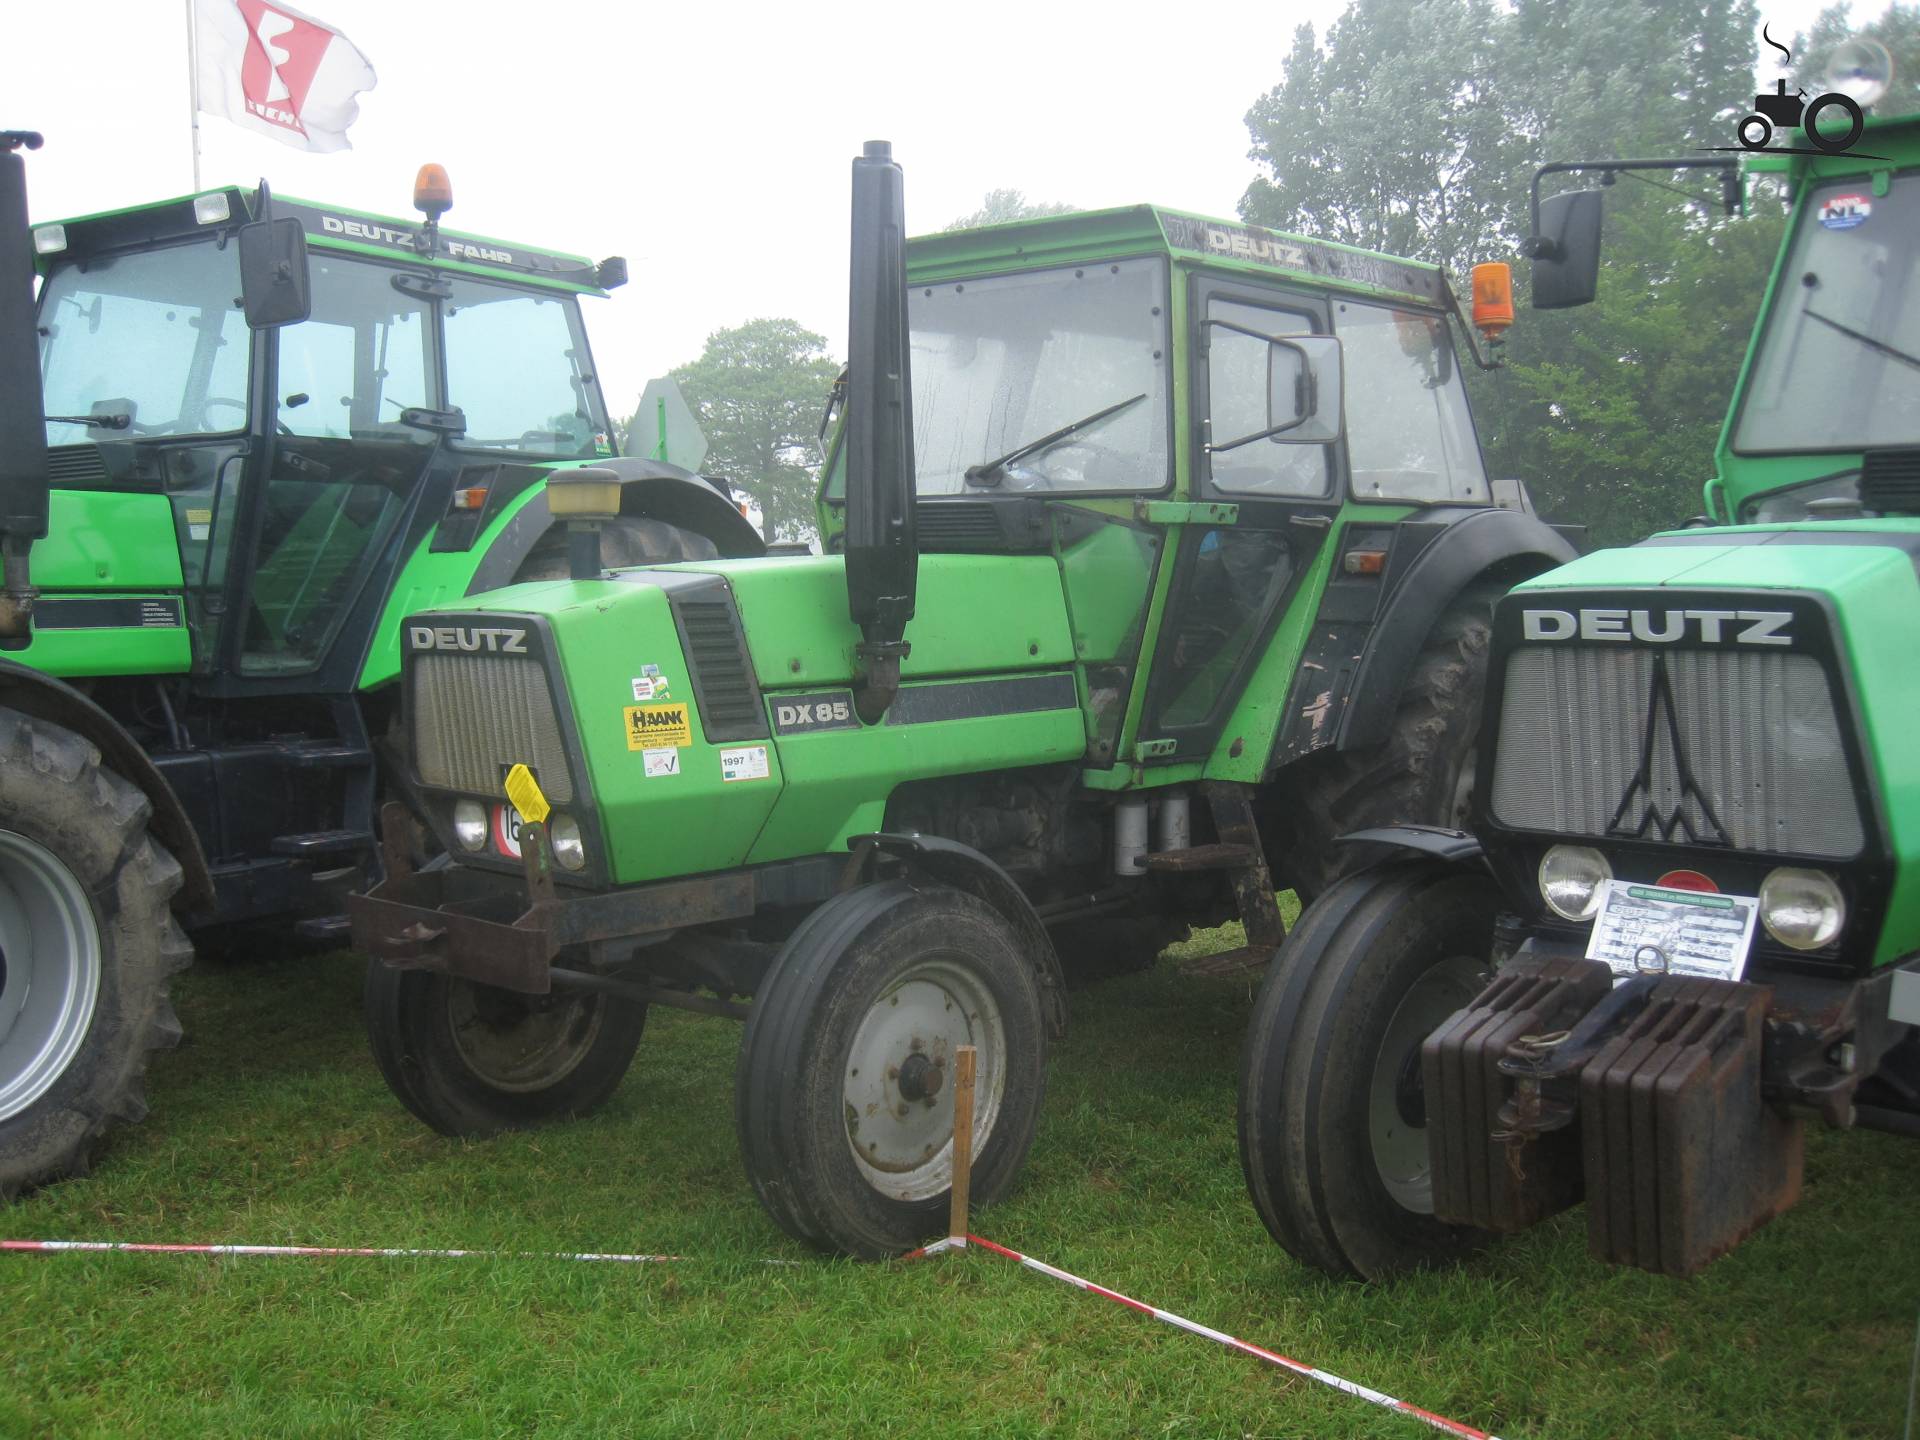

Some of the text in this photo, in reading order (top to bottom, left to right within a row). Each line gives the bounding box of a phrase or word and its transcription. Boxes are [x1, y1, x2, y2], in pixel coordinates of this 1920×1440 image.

[322, 216, 513, 265] DEUTZ FAHR
[1208, 229, 1305, 266] DEUTZ
[1523, 608, 1793, 645] DEUTZ
[410, 627, 527, 653] DEUTZ
[632, 710, 683, 729] HAANK
[777, 701, 850, 726] DX 85
[723, 756, 745, 767] 1997
